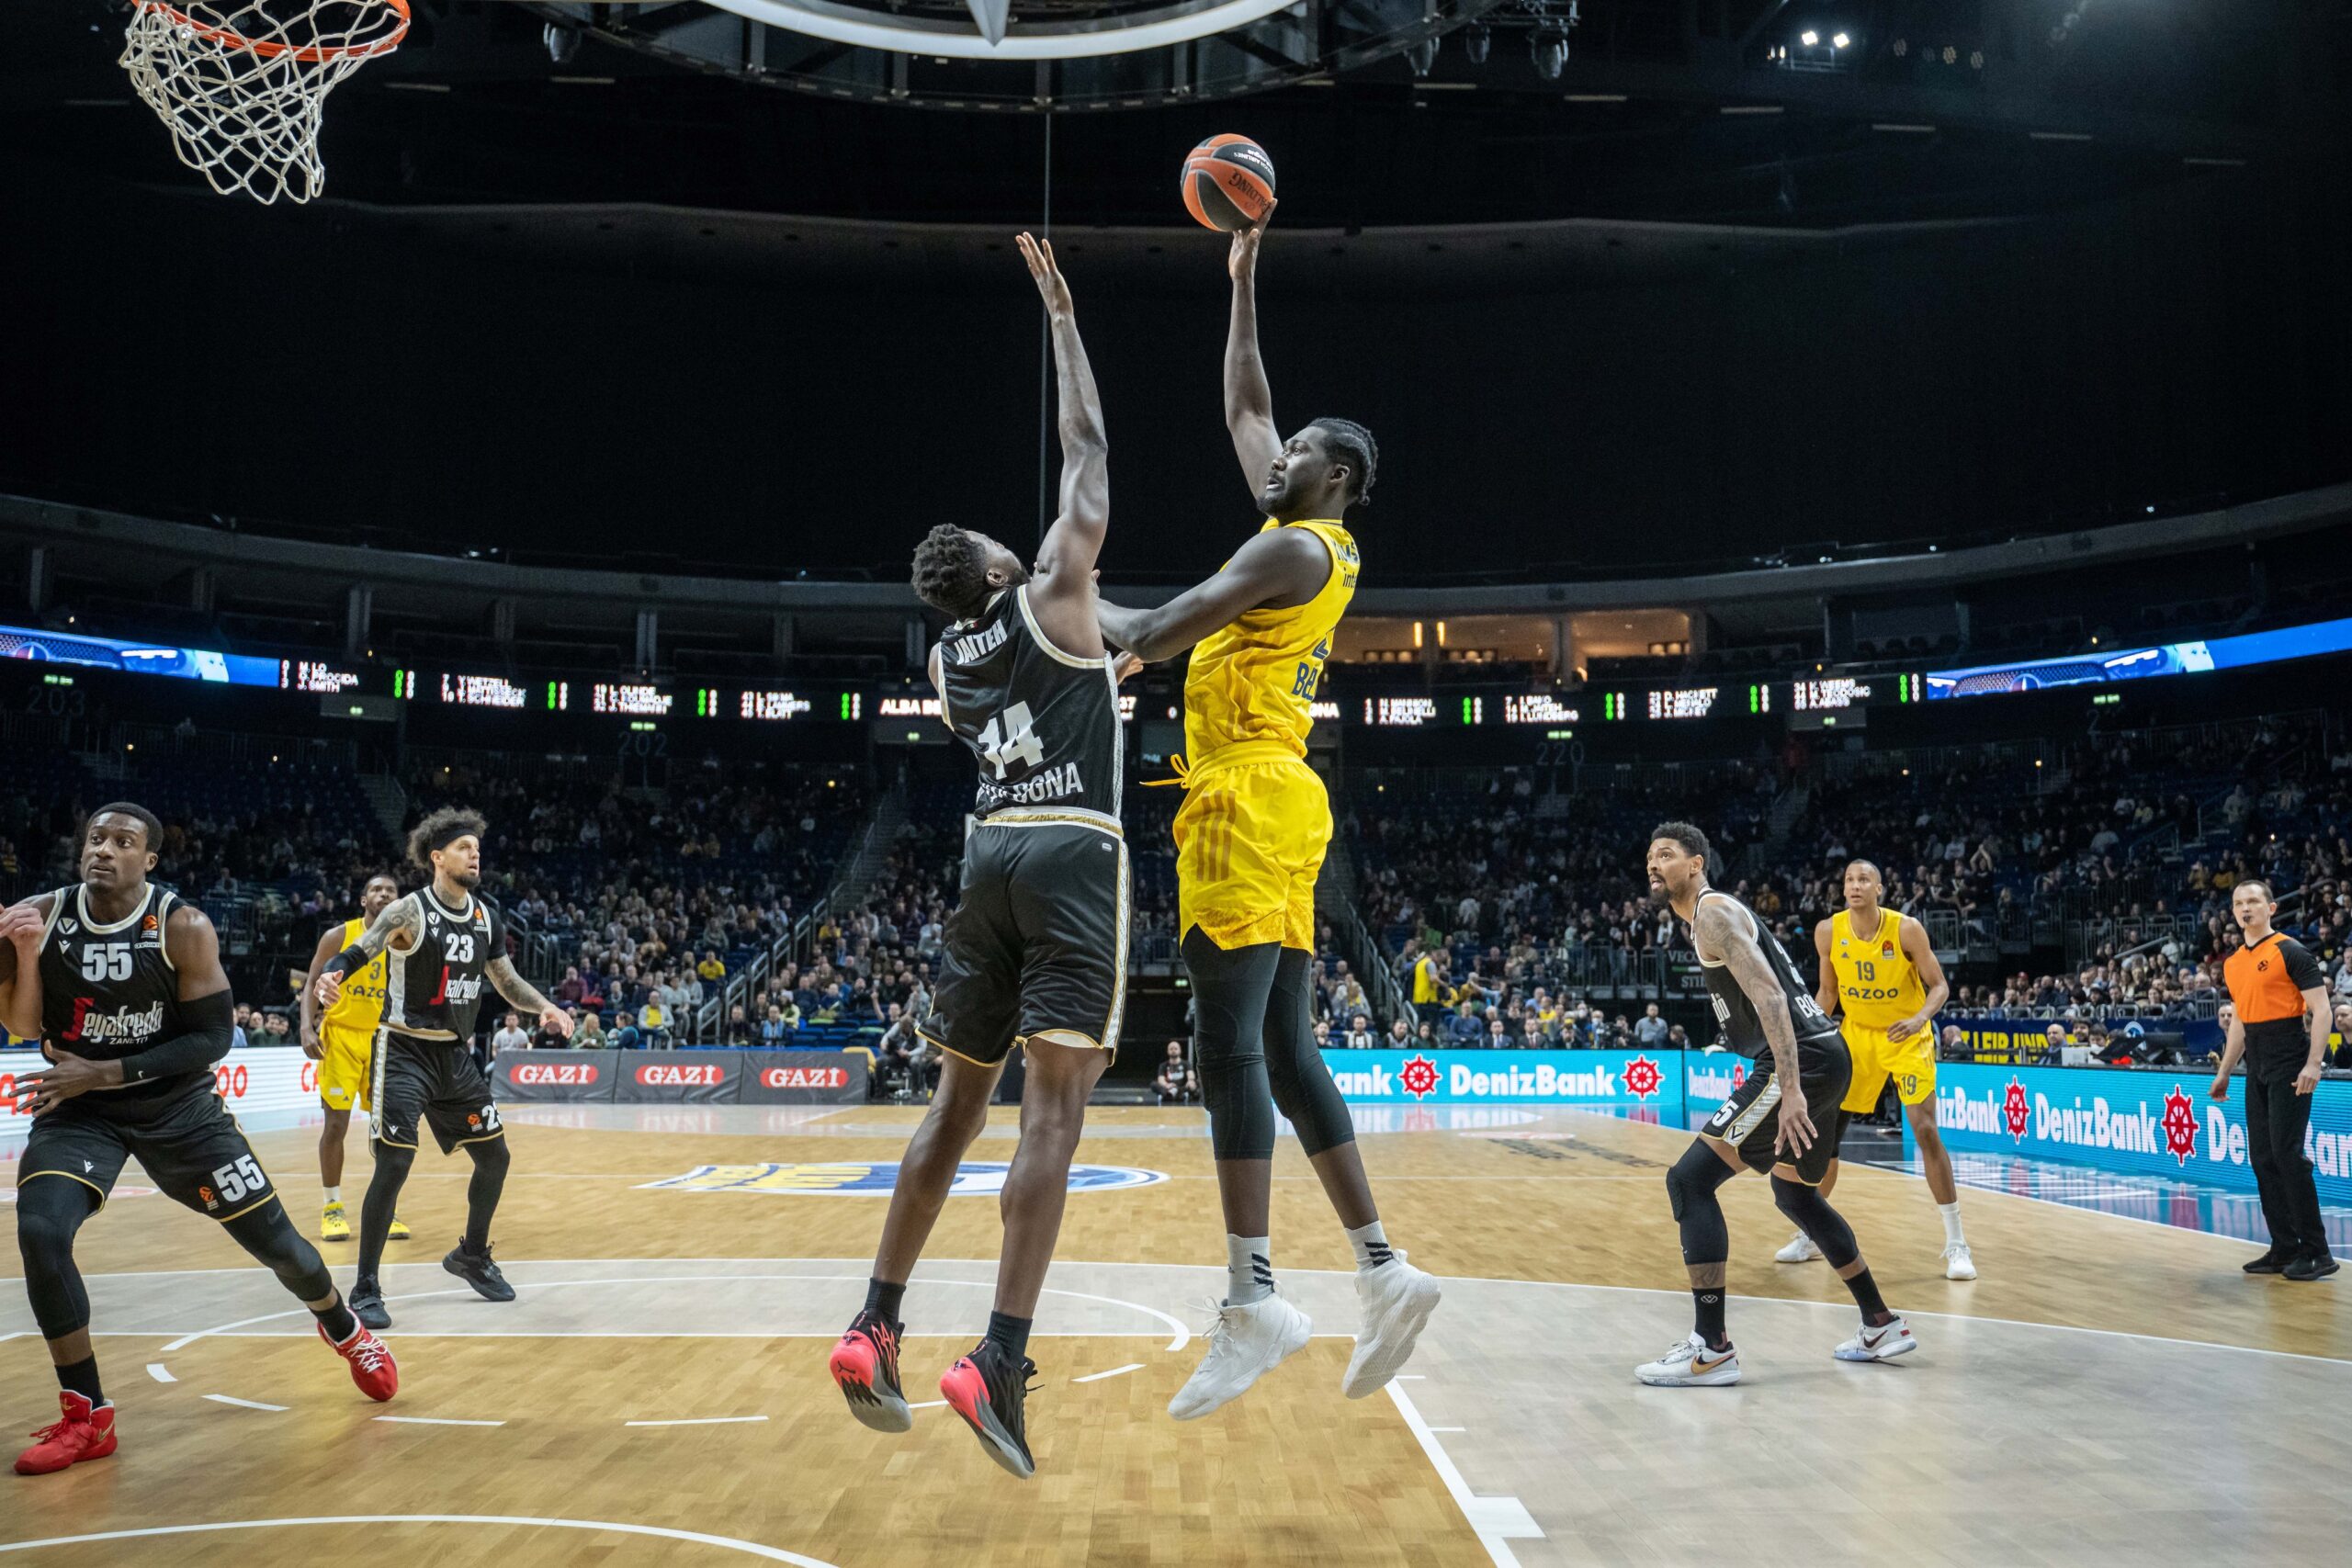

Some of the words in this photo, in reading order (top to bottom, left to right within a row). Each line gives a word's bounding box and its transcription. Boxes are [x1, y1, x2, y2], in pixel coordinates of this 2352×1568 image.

[956, 618, 1008, 666] JAITEH
[879, 698, 922, 716] ALBA
[978, 701, 1045, 780] 14
[82, 942, 132, 981] 55
[445, 933, 474, 964] 23
[369, 961, 382, 980] 3
[1854, 960, 1875, 982] 19
[1450, 1065, 1616, 1096] DenizBank
[2035, 1093, 2158, 1154] DenizBank
[212, 1154, 266, 1202] 55
